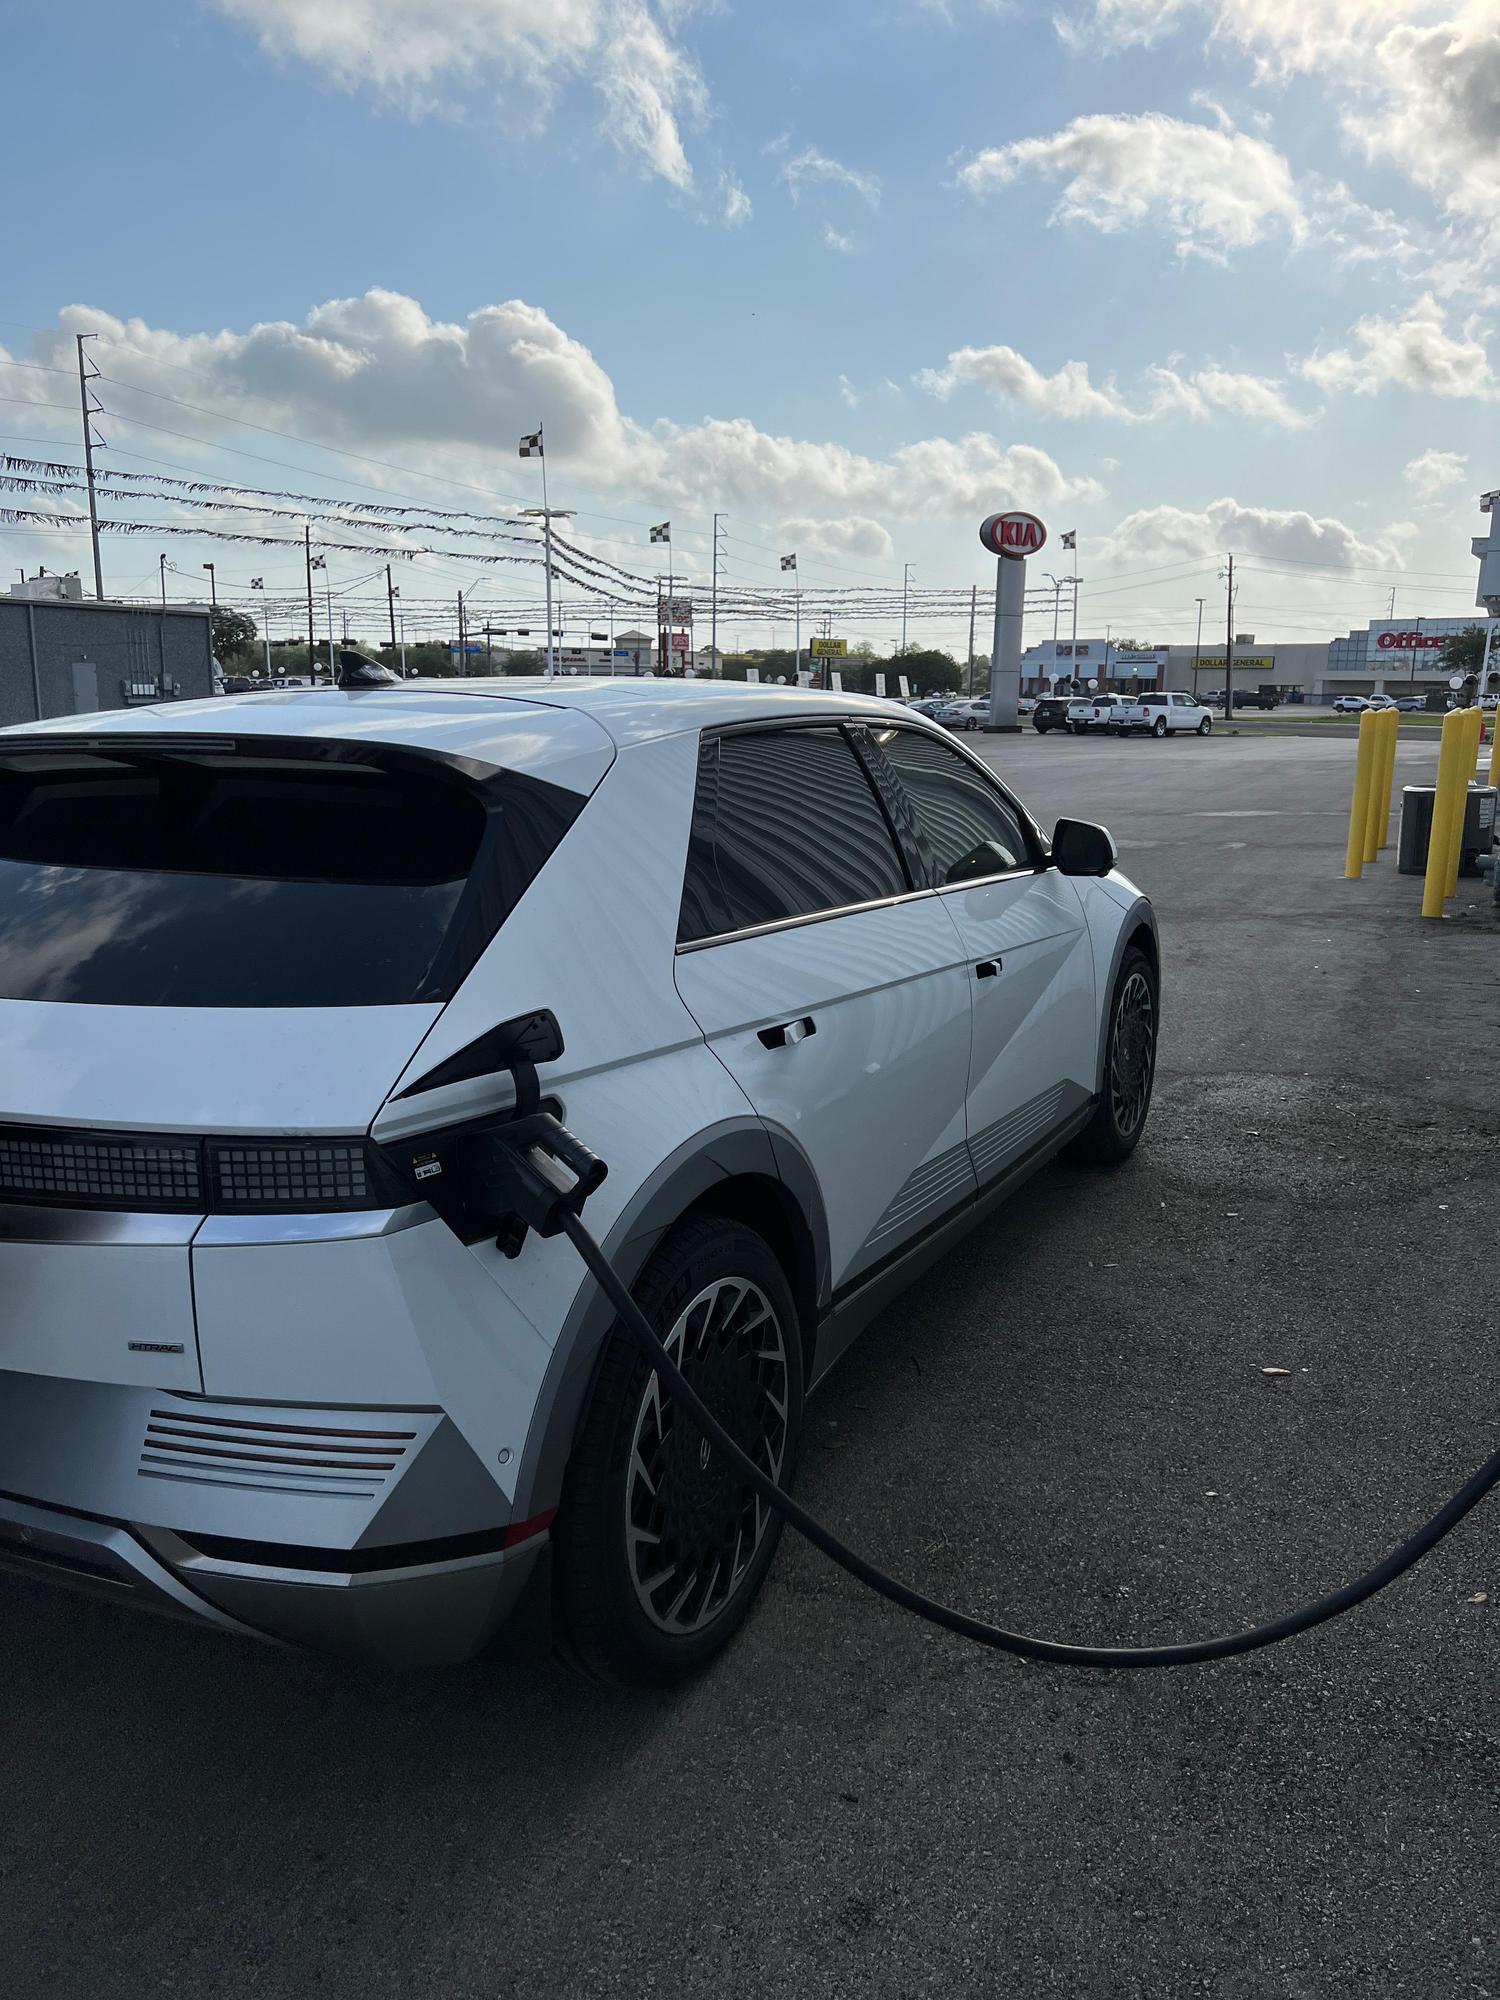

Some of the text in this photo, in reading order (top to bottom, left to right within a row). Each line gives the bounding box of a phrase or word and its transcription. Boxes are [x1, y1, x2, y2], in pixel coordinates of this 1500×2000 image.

[1001, 521, 1038, 548] KIA
[1377, 632, 1445, 649] Office
[818, 641, 842, 649] DOLLAR
[816, 648, 843, 656] GENERAL
[1232, 659, 1265, 667] GENERAL
